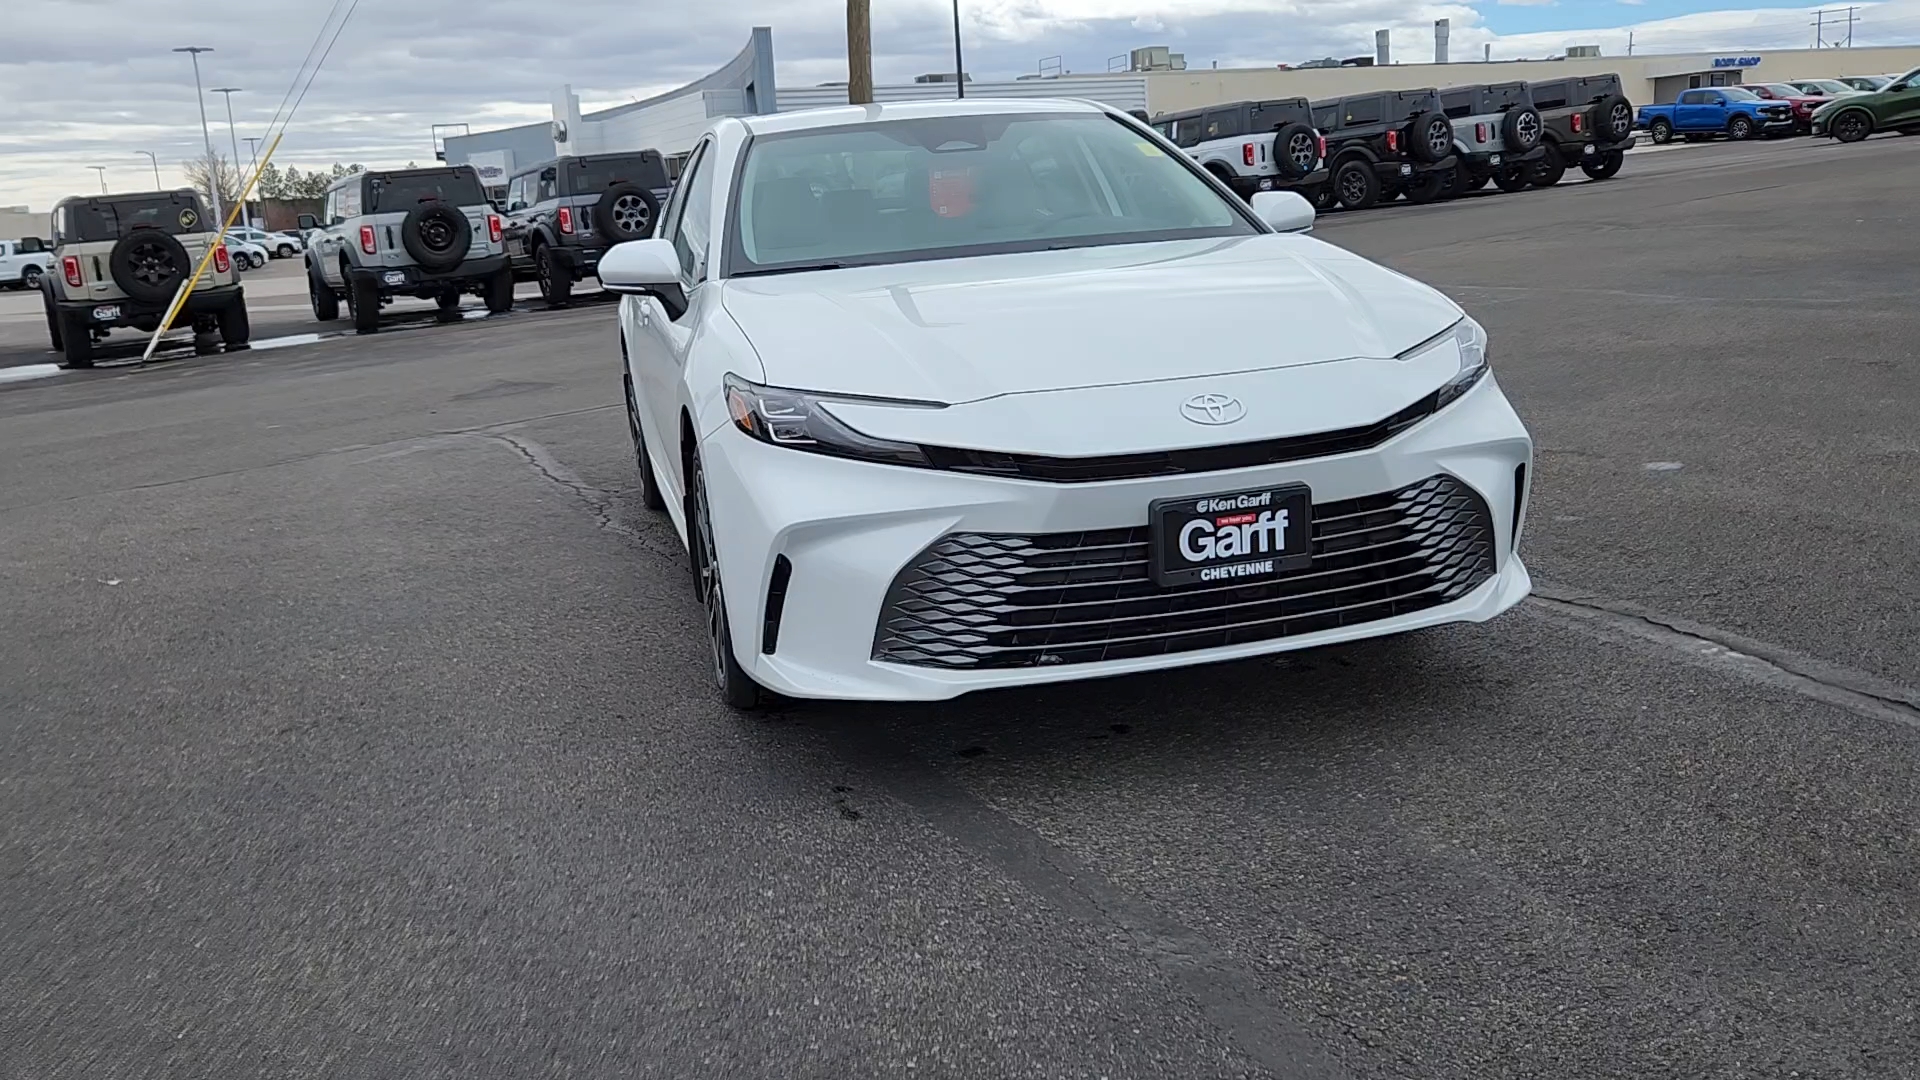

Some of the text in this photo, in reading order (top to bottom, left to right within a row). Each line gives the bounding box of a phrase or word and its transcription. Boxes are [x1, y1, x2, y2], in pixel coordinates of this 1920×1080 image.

[1738, 56, 1761, 66] SHOP
[1209, 493, 1271, 512] Ken Garff
[1179, 509, 1289, 562] Garff
[1201, 561, 1273, 580] CHEYENNE
